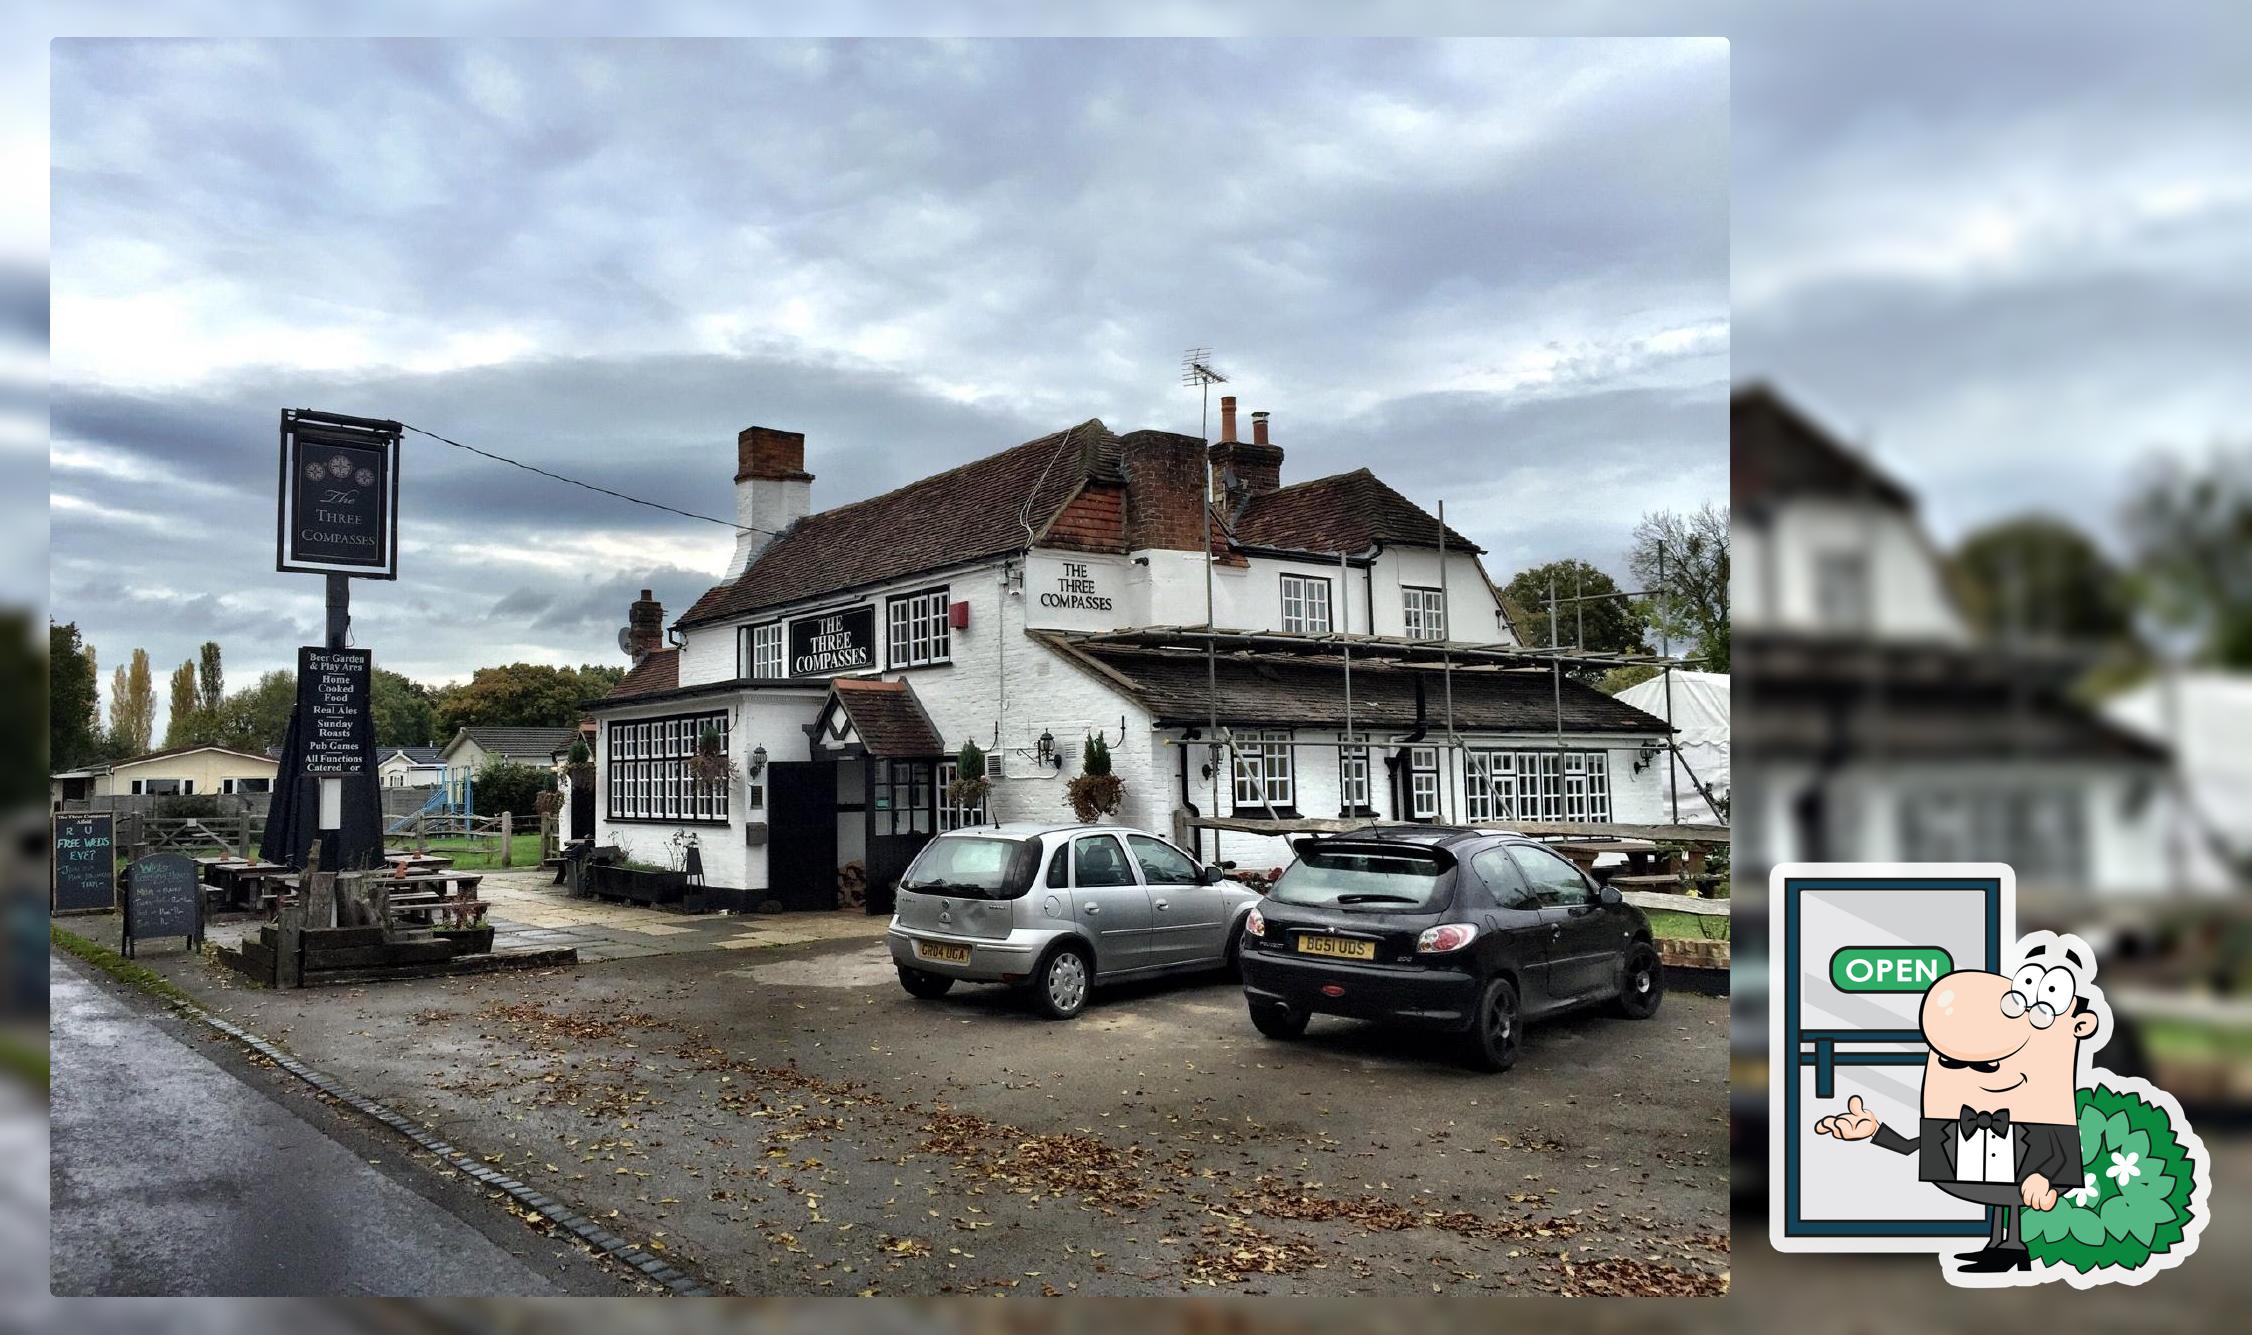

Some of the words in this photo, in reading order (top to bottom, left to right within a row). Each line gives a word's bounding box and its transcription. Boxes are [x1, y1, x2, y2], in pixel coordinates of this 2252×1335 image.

[320, 490, 359, 504] The
[316, 508, 362, 524] THREE
[301, 528, 376, 546] COMPASSES
[1063, 562, 1087, 578] THE
[1058, 578, 1095, 594] THREE
[1041, 593, 1112, 610] COMPASSES
[818, 615, 843, 635] THE
[810, 632, 851, 654] THREE
[310, 653, 329, 662] Beer
[332, 654, 365, 663] Garden
[796, 646, 867, 672] COMPASSES
[310, 662, 318, 670] &
[320, 662, 340, 671] Play
[342, 663, 362, 671] Area
[322, 676, 350, 684] Home
[318, 684, 354, 693] Cooked
[324, 694, 348, 702] Food
[314, 706, 335, 714] Real
[338, 706, 358, 715] Ales
[318, 720, 353, 730] Sunday
[319, 729, 350, 737] Roasts
[310, 742, 327, 750] Pub
[330, 742, 359, 750] Games
[320, 755, 362, 763] Functions
[307, 764, 342, 772] Catered
[66, 827, 74, 836] R
[84, 826, 92, 834] U
[57, 838, 80, 848] FREE
[70, 850, 96, 860] EVE?
[1306, 936, 1335, 952] BG51
[1339, 940, 1365, 956] UDS
[921, 944, 944, 960] GR04
